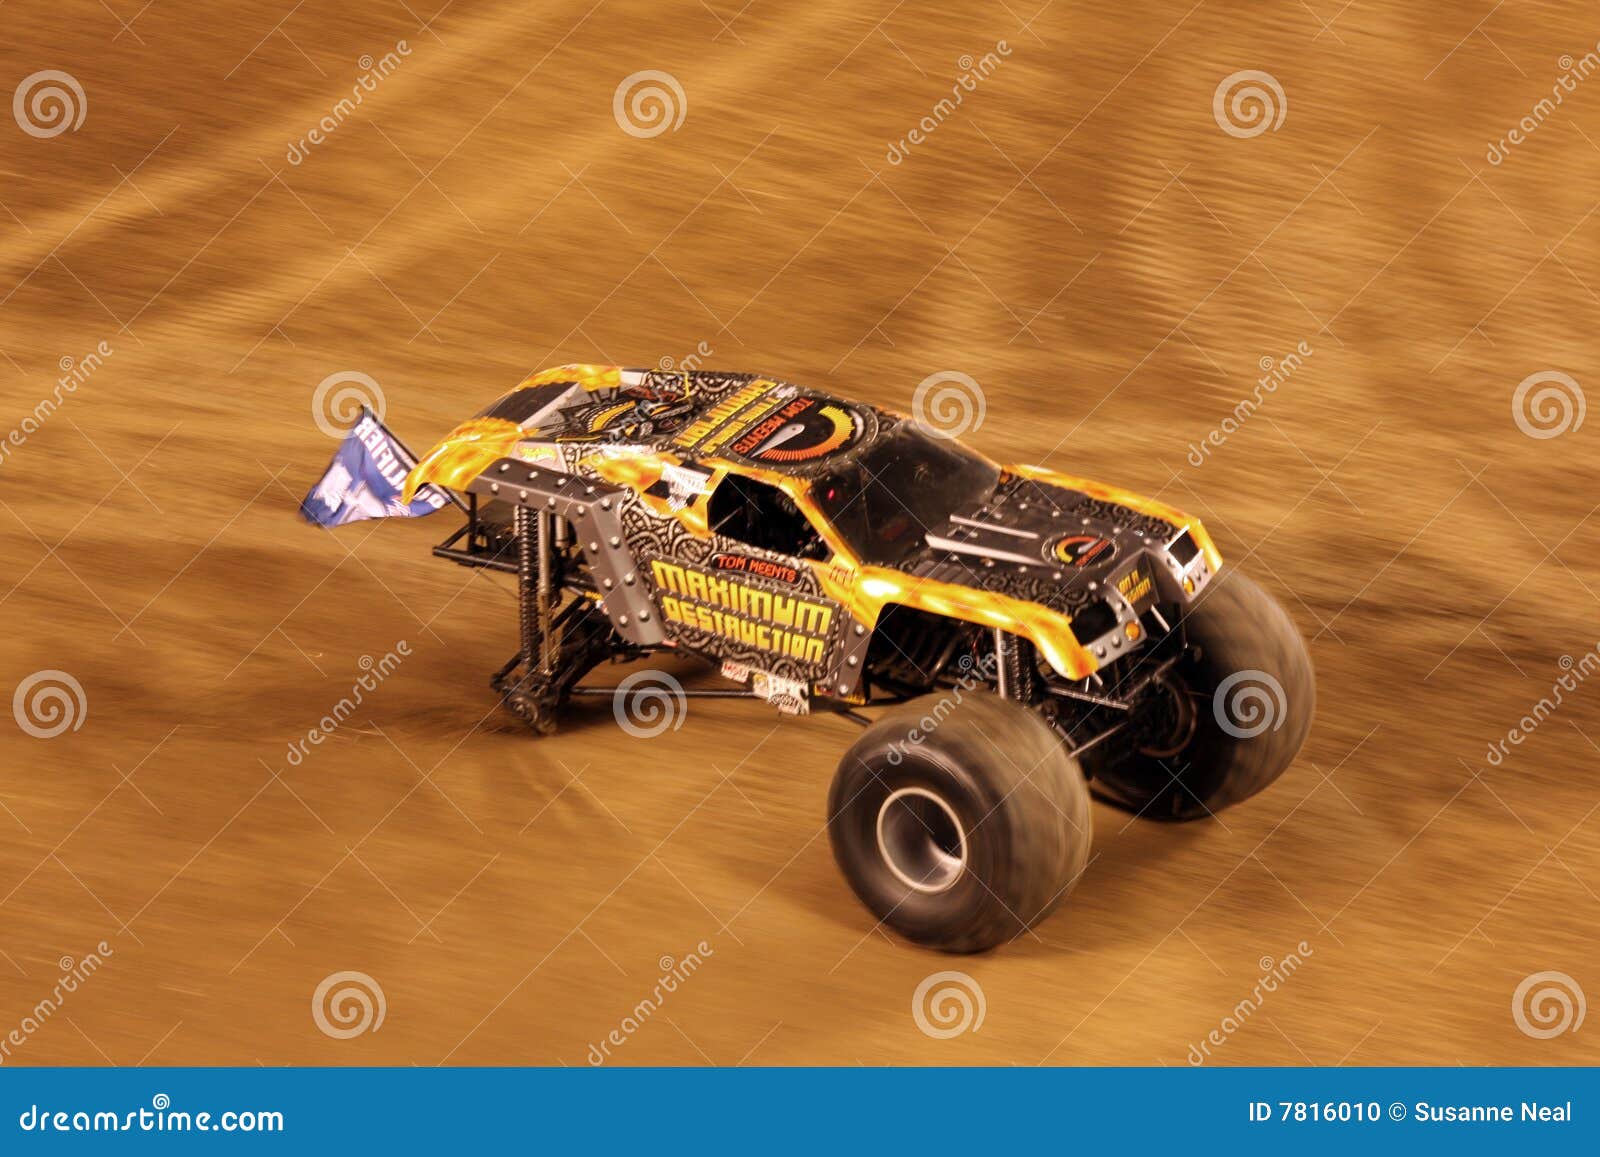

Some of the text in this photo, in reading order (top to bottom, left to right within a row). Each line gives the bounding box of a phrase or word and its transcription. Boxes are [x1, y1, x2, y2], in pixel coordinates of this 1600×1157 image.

[730, 396, 816, 455] TOM MEENTS
[651, 559, 833, 635] MAXIMUM
[718, 555, 797, 583] TOM MEENTS
[662, 595, 825, 664] DESTRUCTION
